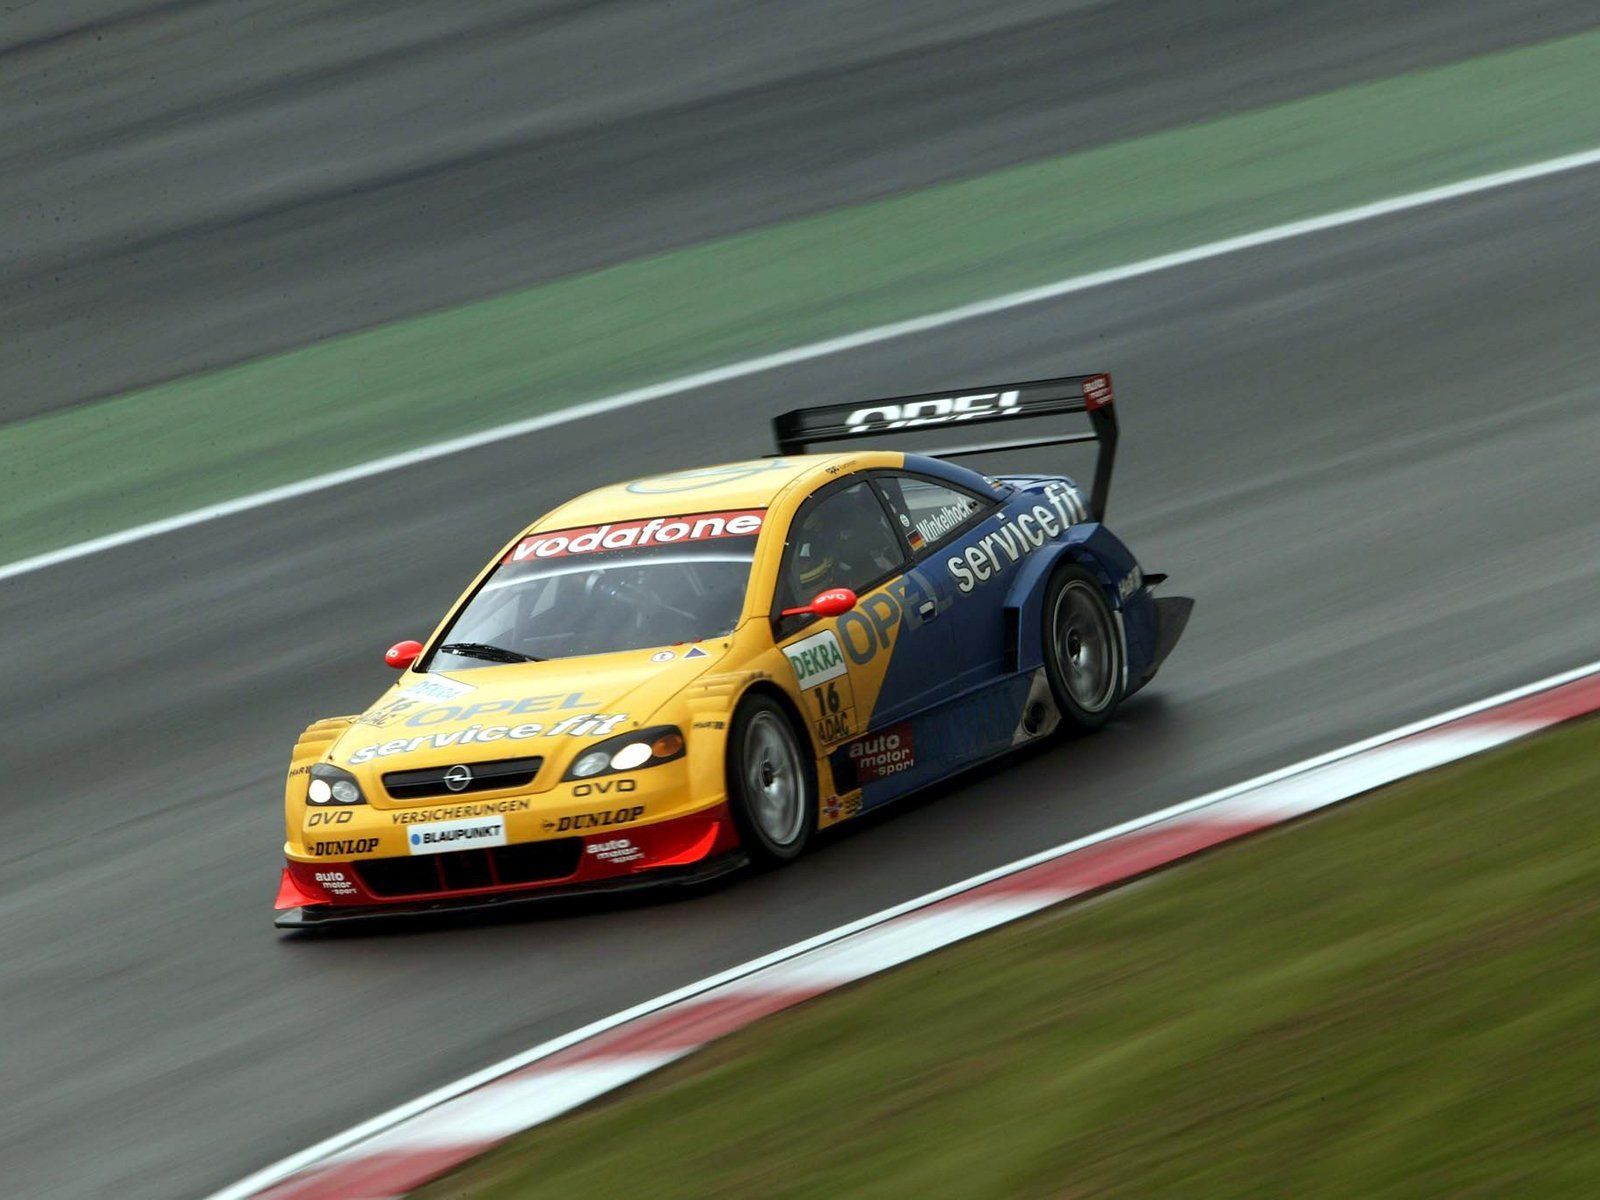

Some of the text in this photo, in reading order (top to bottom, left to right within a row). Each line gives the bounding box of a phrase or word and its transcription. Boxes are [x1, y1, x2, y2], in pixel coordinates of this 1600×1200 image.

[916, 497, 973, 543] Winkelhock
[512, 515, 762, 561] vodafone
[947, 504, 1060, 594] service
[1043, 481, 1089, 530] fit
[789, 640, 843, 680] DEKRA
[404, 692, 600, 728] OPEL
[814, 682, 839, 716] 16
[350, 713, 628, 764] service fit
[850, 733, 900, 757] auto
[860, 748, 910, 768] motor
[572, 779, 637, 797] OVD
[308, 811, 353, 827] OVD
[392, 799, 531, 825] VERSICHERUNGEN
[557, 806, 645, 832] DUNLOP
[315, 838, 379, 856] DUNLOP
[423, 825, 501, 844] BLAUPUNKT
[586, 839, 631, 854] auto
[315, 872, 345, 881] auto
